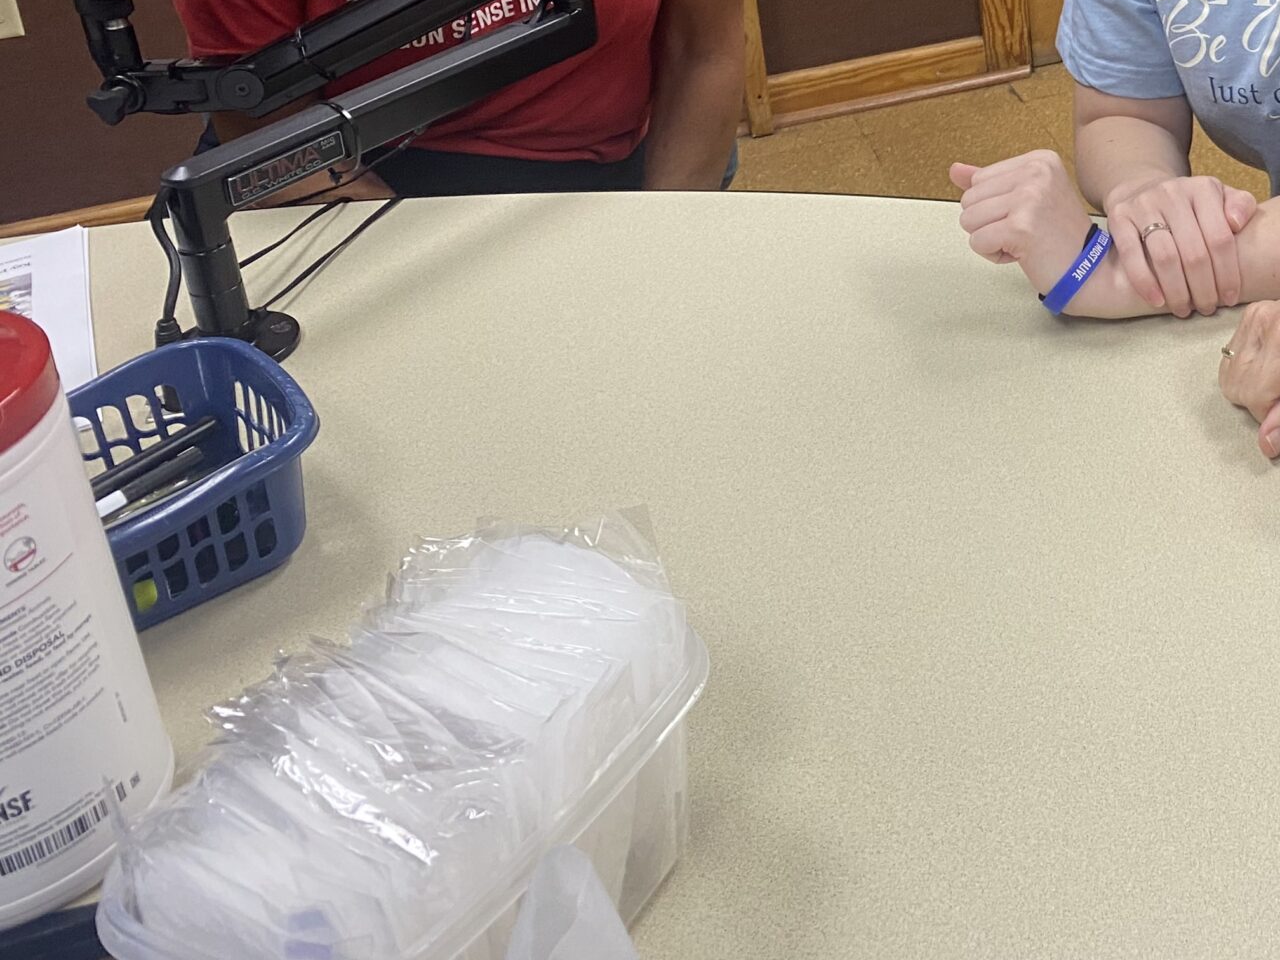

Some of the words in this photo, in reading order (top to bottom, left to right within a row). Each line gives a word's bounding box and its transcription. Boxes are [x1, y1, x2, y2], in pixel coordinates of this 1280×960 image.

[1208, 76, 1264, 105] Just
[234, 145, 321, 194] ULTIMA
[1088, 242, 1104, 263] MOST
[1071, 258, 1092, 281] ALIVE
[14, 631, 65, 668] DISPOSAL
